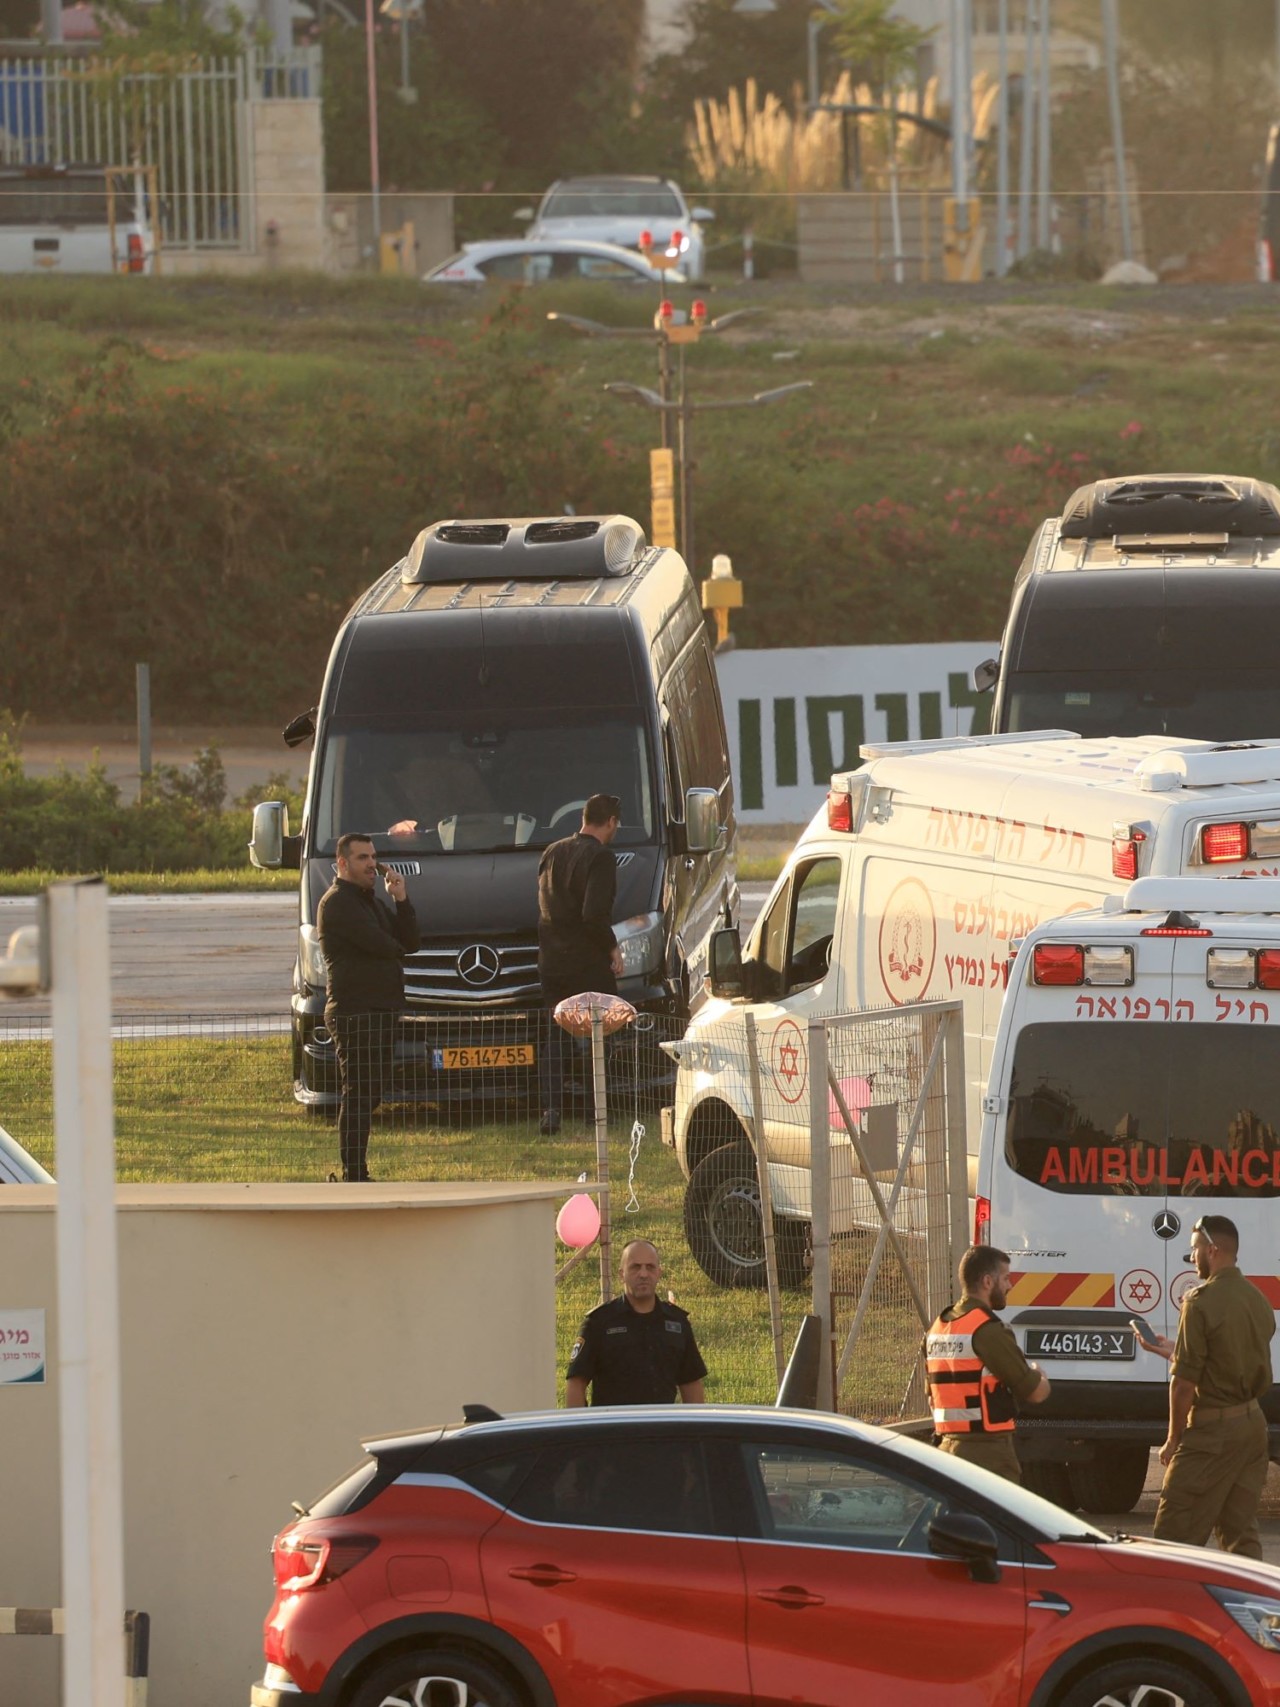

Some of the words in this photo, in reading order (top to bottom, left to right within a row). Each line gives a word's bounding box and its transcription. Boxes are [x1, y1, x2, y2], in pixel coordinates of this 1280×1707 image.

[924, 806, 1027, 859] הרפואה
[1039, 813, 1086, 868] חיל
[944, 953, 985, 992] נמרץ
[1075, 994, 1195, 1021] הרפואה
[1215, 992, 1269, 1023] חיל
